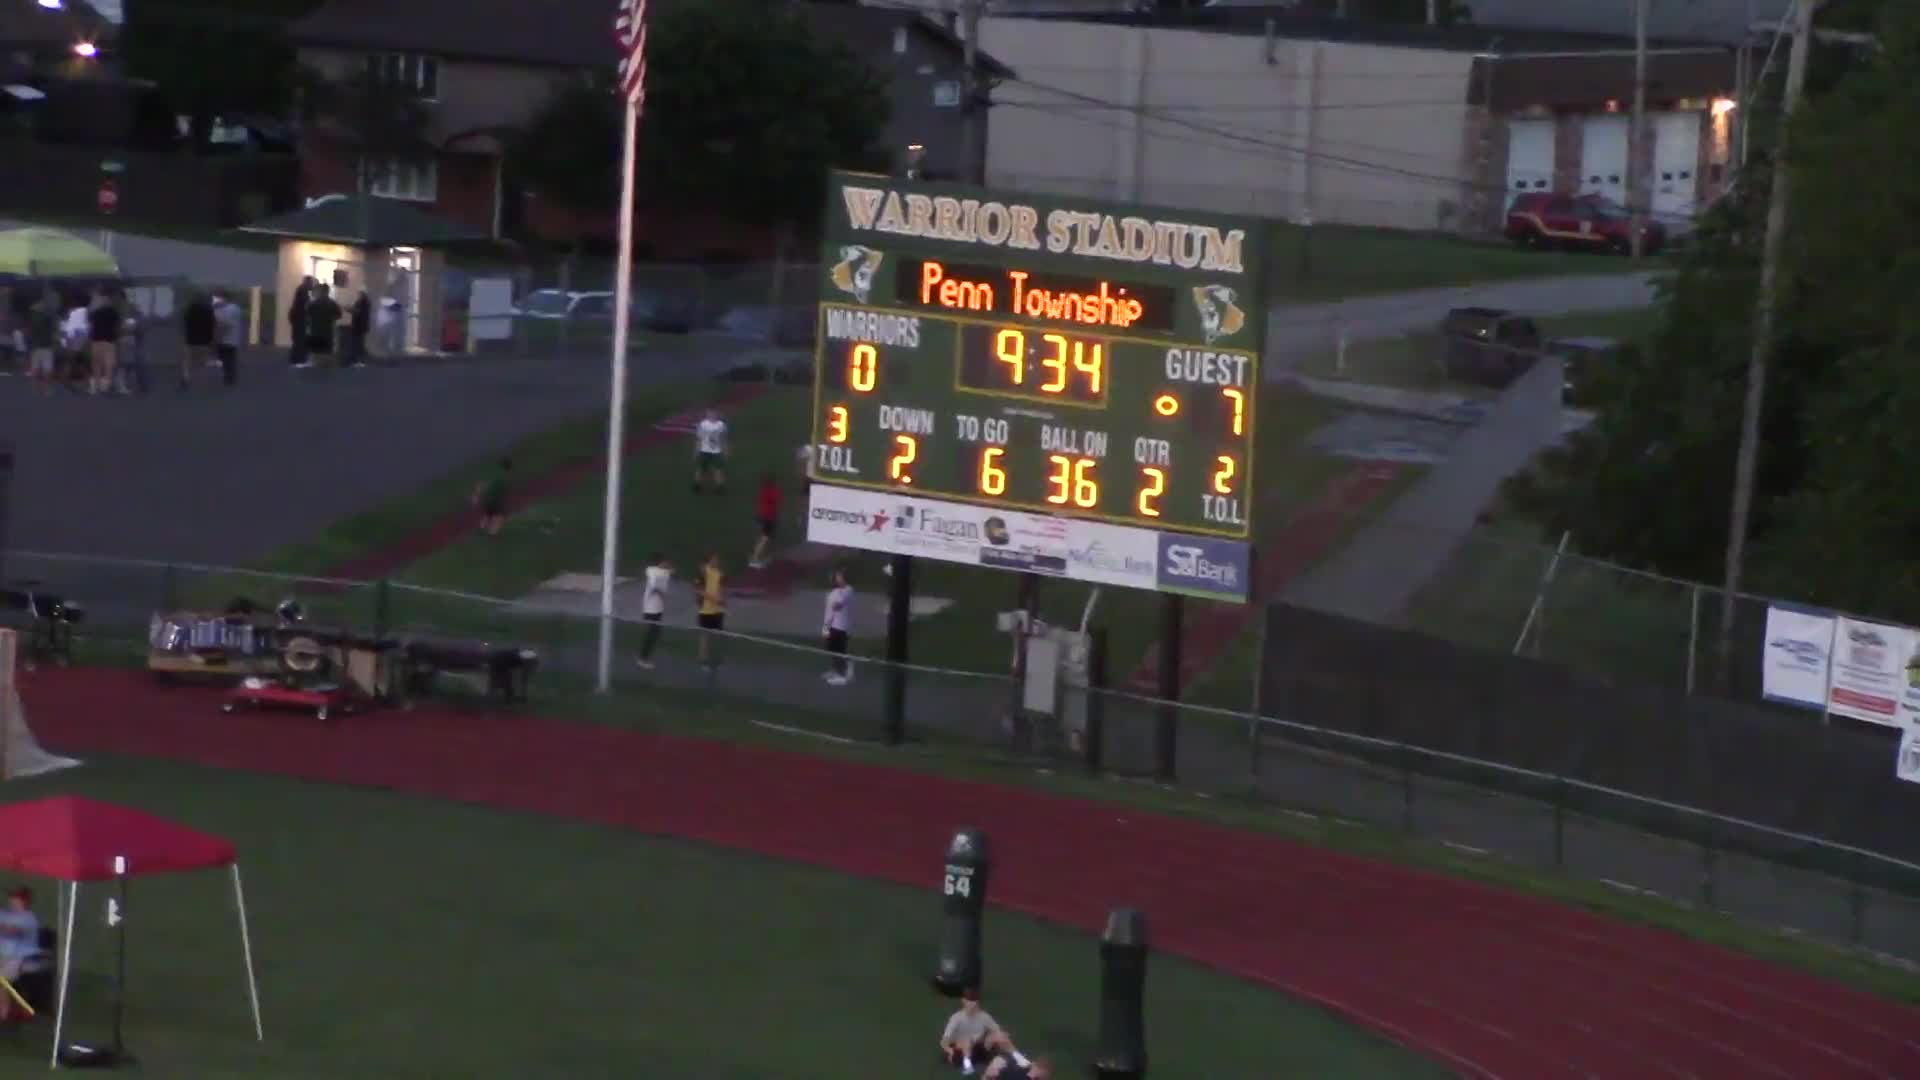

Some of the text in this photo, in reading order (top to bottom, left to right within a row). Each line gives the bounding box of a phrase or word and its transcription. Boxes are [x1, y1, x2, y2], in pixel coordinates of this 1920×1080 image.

[843, 186, 1245, 273] WARRIOR STADIUM
[922, 262, 1143, 327] Penn Township
[827, 308, 920, 348] WARRIORS
[851, 344, 877, 392] 0
[996, 330, 1103, 394] 9:34
[1165, 348, 1248, 387] GUEST
[830, 406, 849, 442] 3
[879, 406, 934, 435] DOWN
[956, 415, 1008, 444] TO GO
[1223, 388, 1244, 436] 7
[1041, 427, 1107, 457] BALL ON
[1134, 437, 1170, 466] QTR
[983, 448, 1005, 496] 6
[1047, 456, 1097, 508] 36
[1214, 457, 1234, 494] 2
[1139, 469, 1164, 517] 2
[811, 506, 868, 526] aramark
[1198, 558, 1238, 587] Bank
[944, 873, 971, 898] 64
